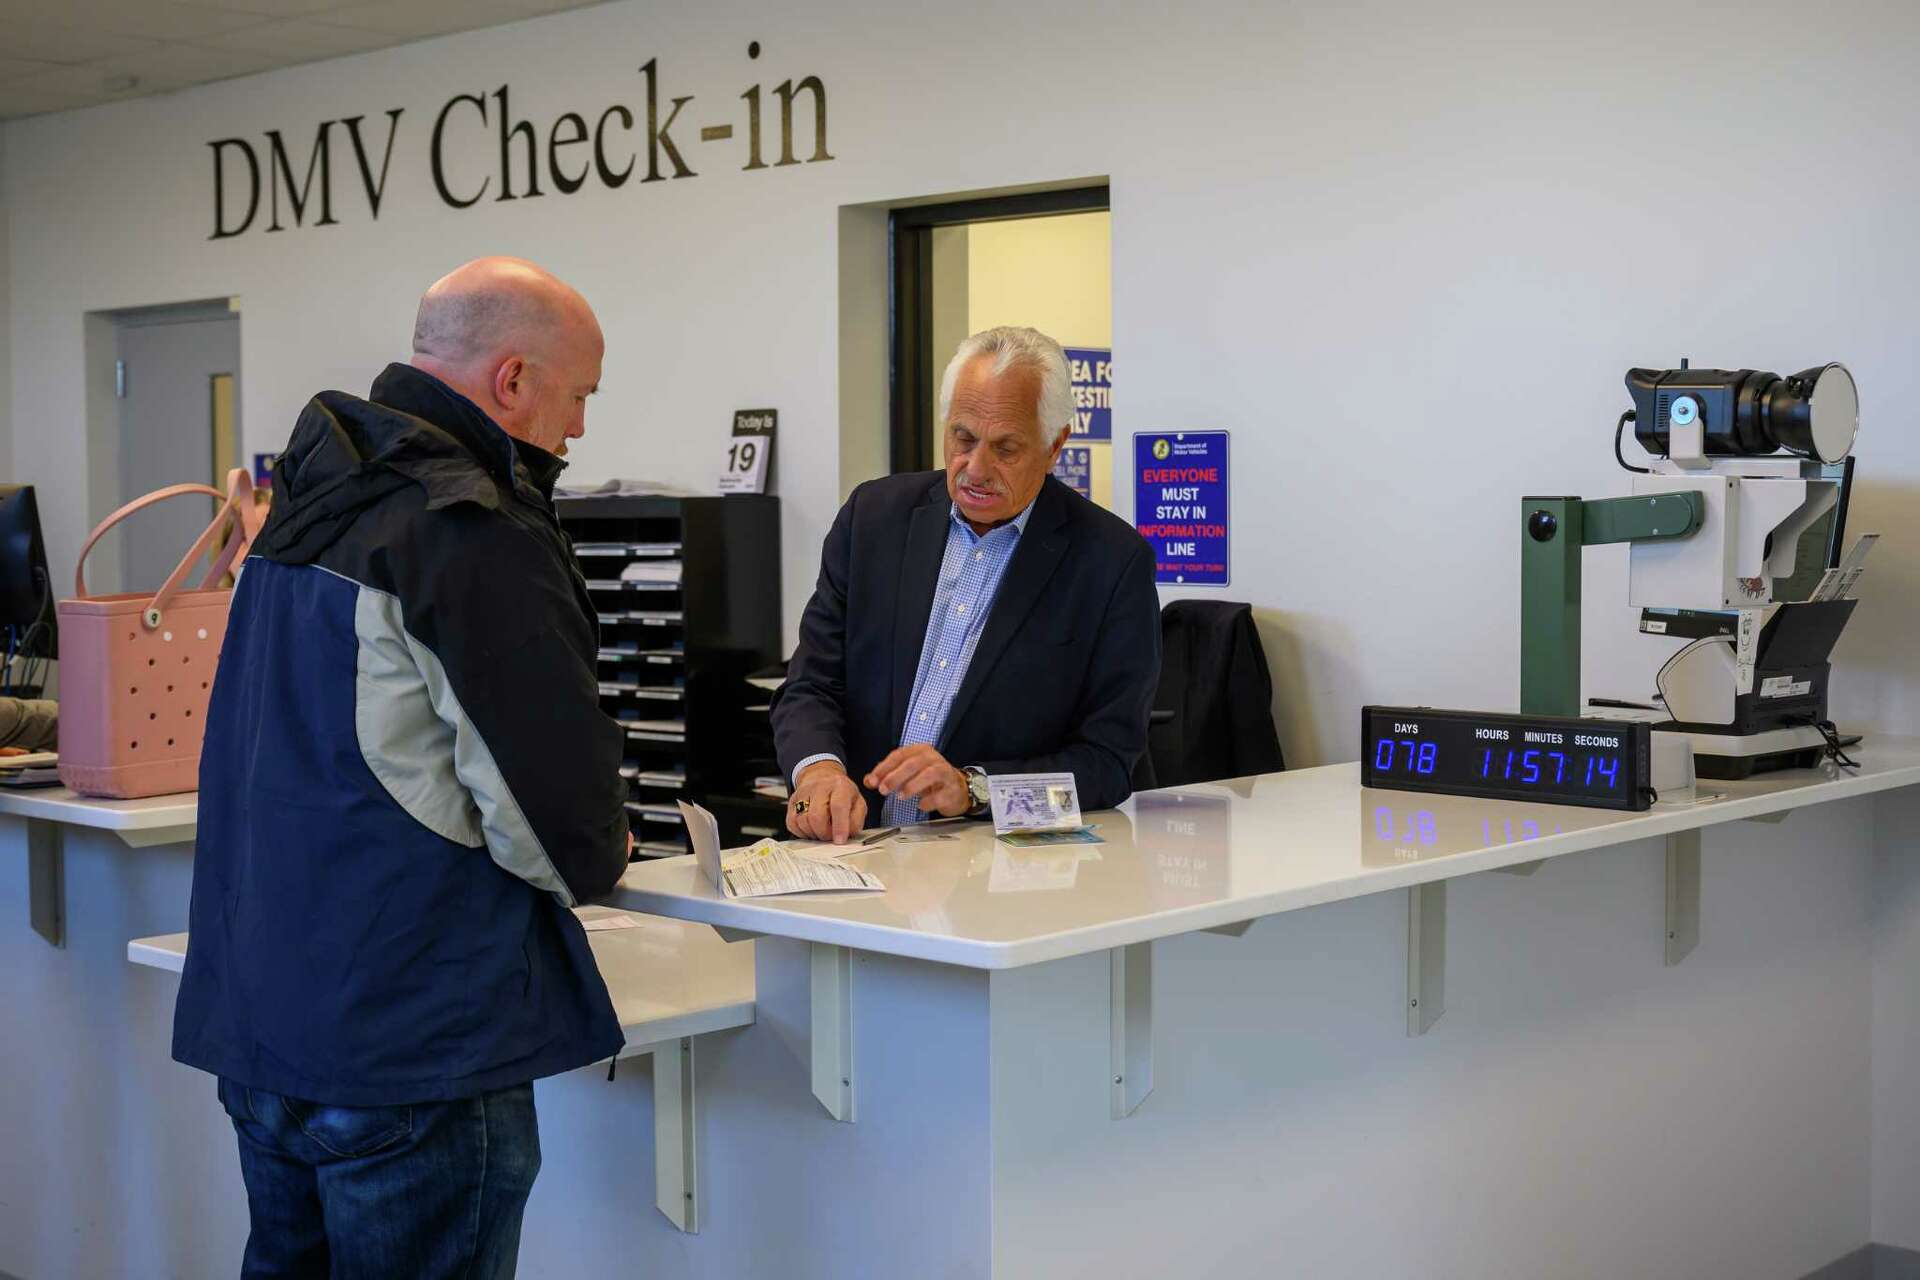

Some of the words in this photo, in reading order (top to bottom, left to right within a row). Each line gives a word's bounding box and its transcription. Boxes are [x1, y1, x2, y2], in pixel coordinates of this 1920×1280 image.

[206, 108, 405, 240] DMV
[430, 41, 835, 209] Check-in
[1071, 360, 1093, 383] EA
[1096, 361, 1112, 384] FO
[737, 415, 762, 431] Today
[1070, 411, 1093, 434] LY
[728, 443, 756, 472] 19
[1143, 466, 1218, 483] EVERYONE
[1162, 487, 1200, 501] MUST
[1156, 505, 1190, 519] STAY
[1192, 505, 1206, 519] IN
[1138, 523, 1225, 537] INFORMATION
[1166, 541, 1196, 556] LINE
[1394, 723, 1419, 734] DAYS
[1475, 728, 1510, 740] HOURS
[1524, 731, 1563, 744] MINUTES
[1574, 734, 1619, 748] SECONDS
[1376, 738, 1438, 774] 078
